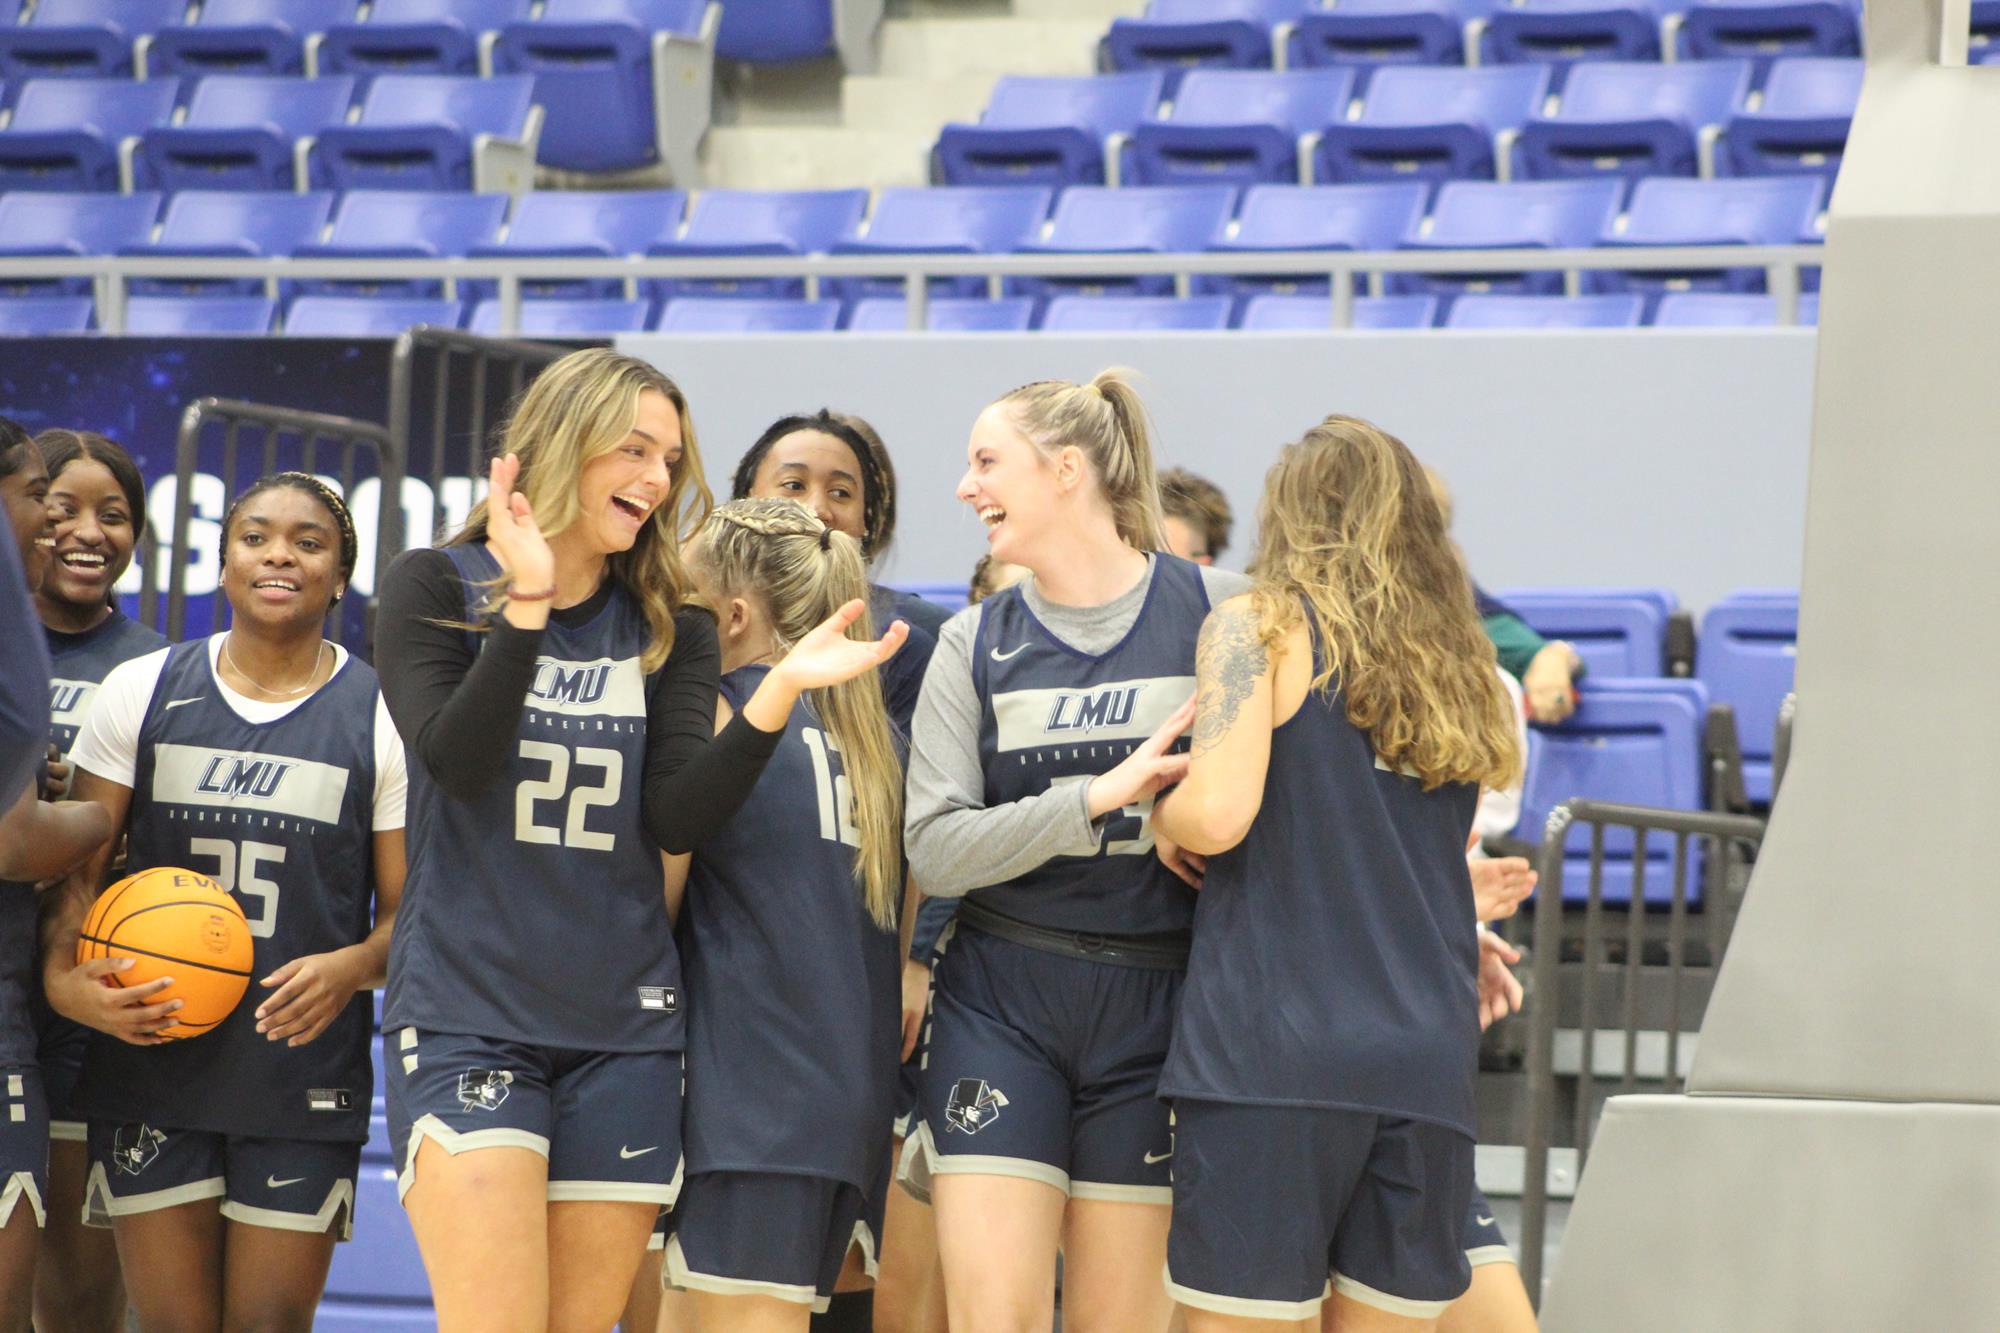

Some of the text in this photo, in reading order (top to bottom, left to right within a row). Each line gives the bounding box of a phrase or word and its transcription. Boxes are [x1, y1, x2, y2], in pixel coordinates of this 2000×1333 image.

[1044, 684, 1148, 734] LMU
[195, 754, 300, 801] LMU
[515, 739, 624, 851] 22
[169, 809, 316, 836] BASKETBALL
[666, 993, 675, 1005] M
[341, 1095, 348, 1105] L
